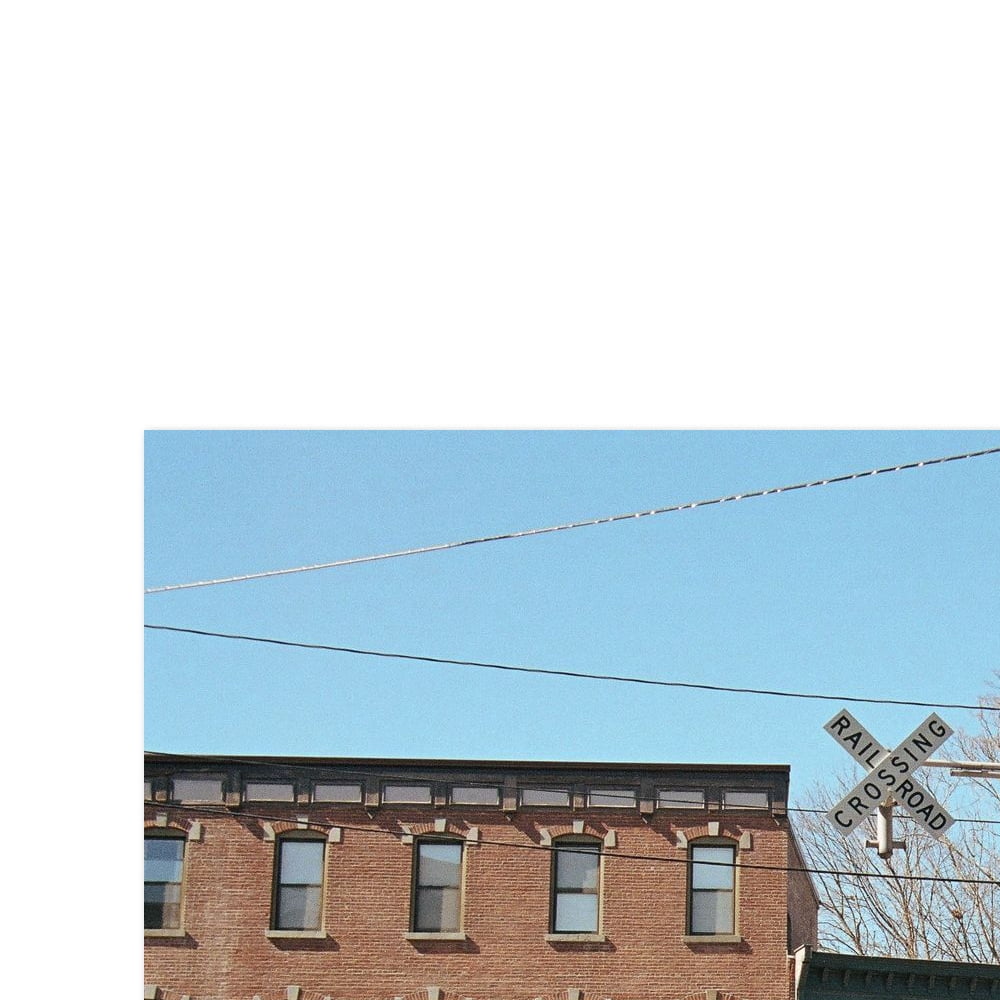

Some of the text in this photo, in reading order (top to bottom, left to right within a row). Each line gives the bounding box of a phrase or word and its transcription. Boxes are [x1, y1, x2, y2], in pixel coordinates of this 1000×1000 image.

[831, 715, 947, 831] RAIL ROAD
[834, 720, 946, 828] CROSSING
